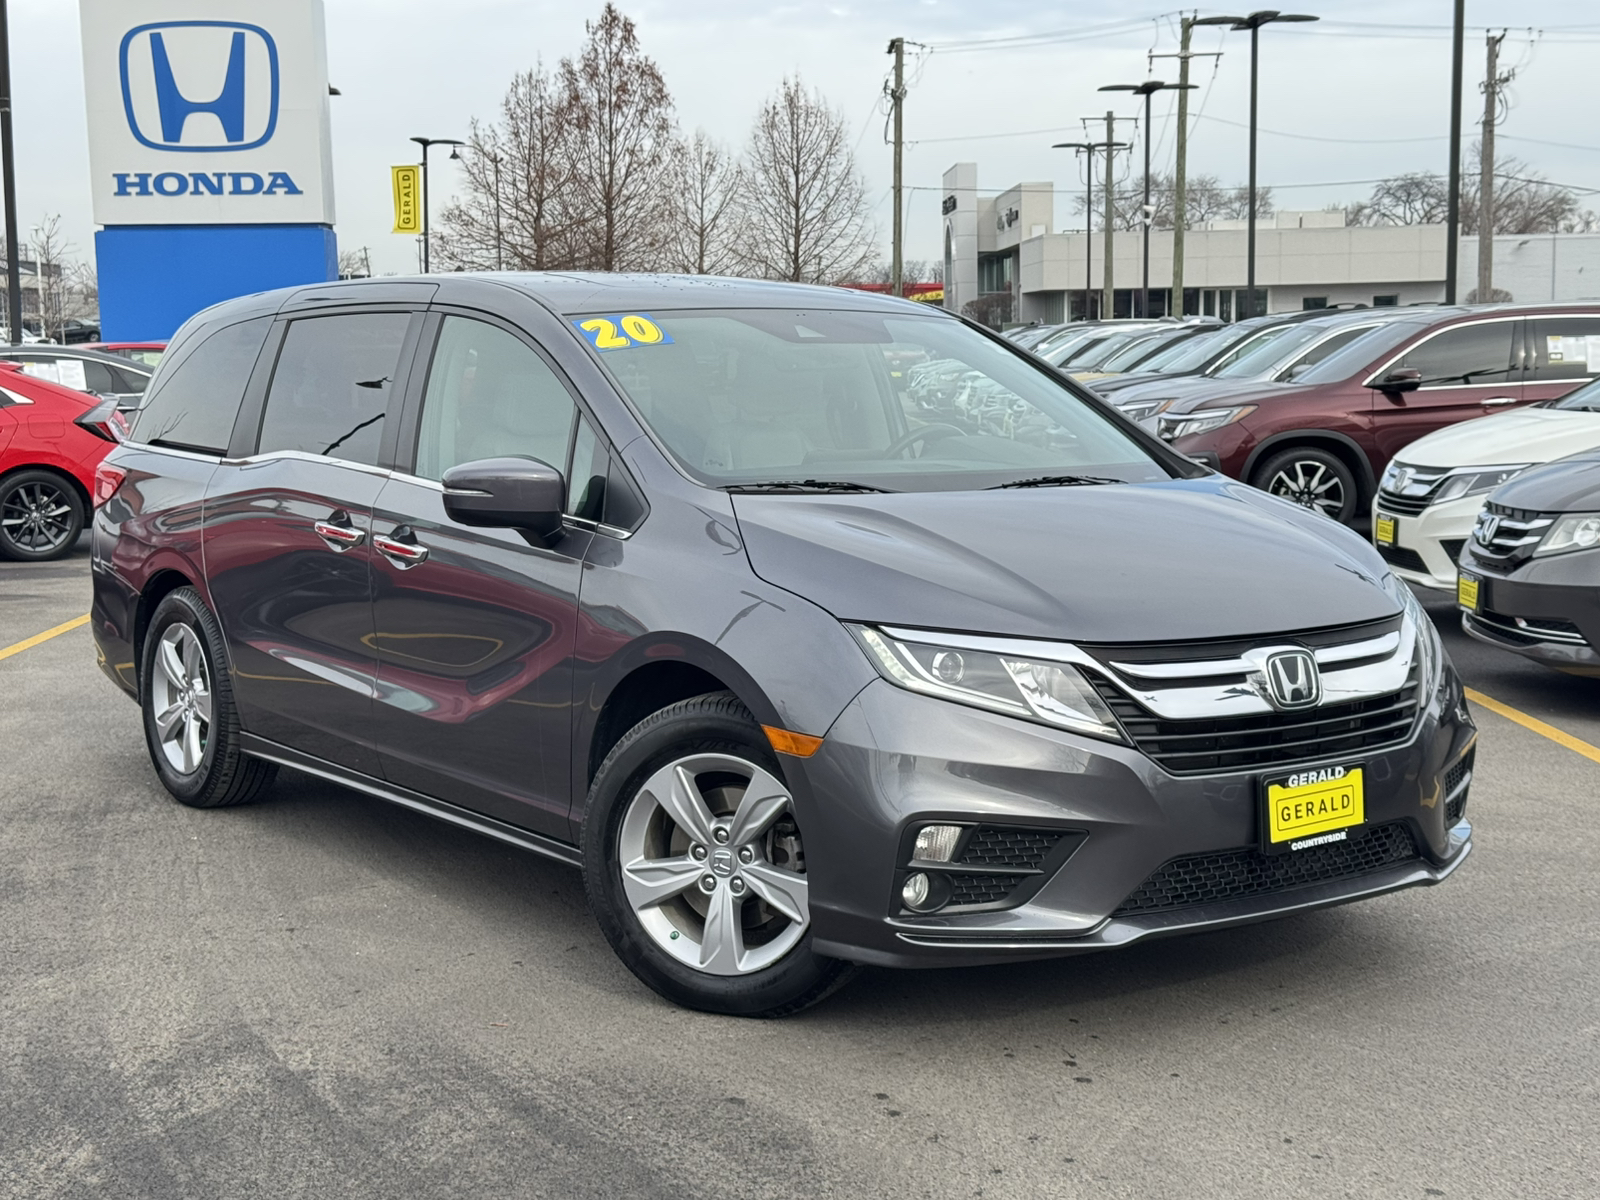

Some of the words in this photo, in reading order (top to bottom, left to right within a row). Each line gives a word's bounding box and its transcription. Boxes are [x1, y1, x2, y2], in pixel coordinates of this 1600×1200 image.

[112, 171, 304, 197] HONDA
[401, 174, 412, 225] GERALD
[580, 315, 664, 349] 20
[1287, 766, 1345, 788] GERALD
[1280, 794, 1351, 823] GERALD
[1290, 831, 1347, 852] COUNTRYSIDE
